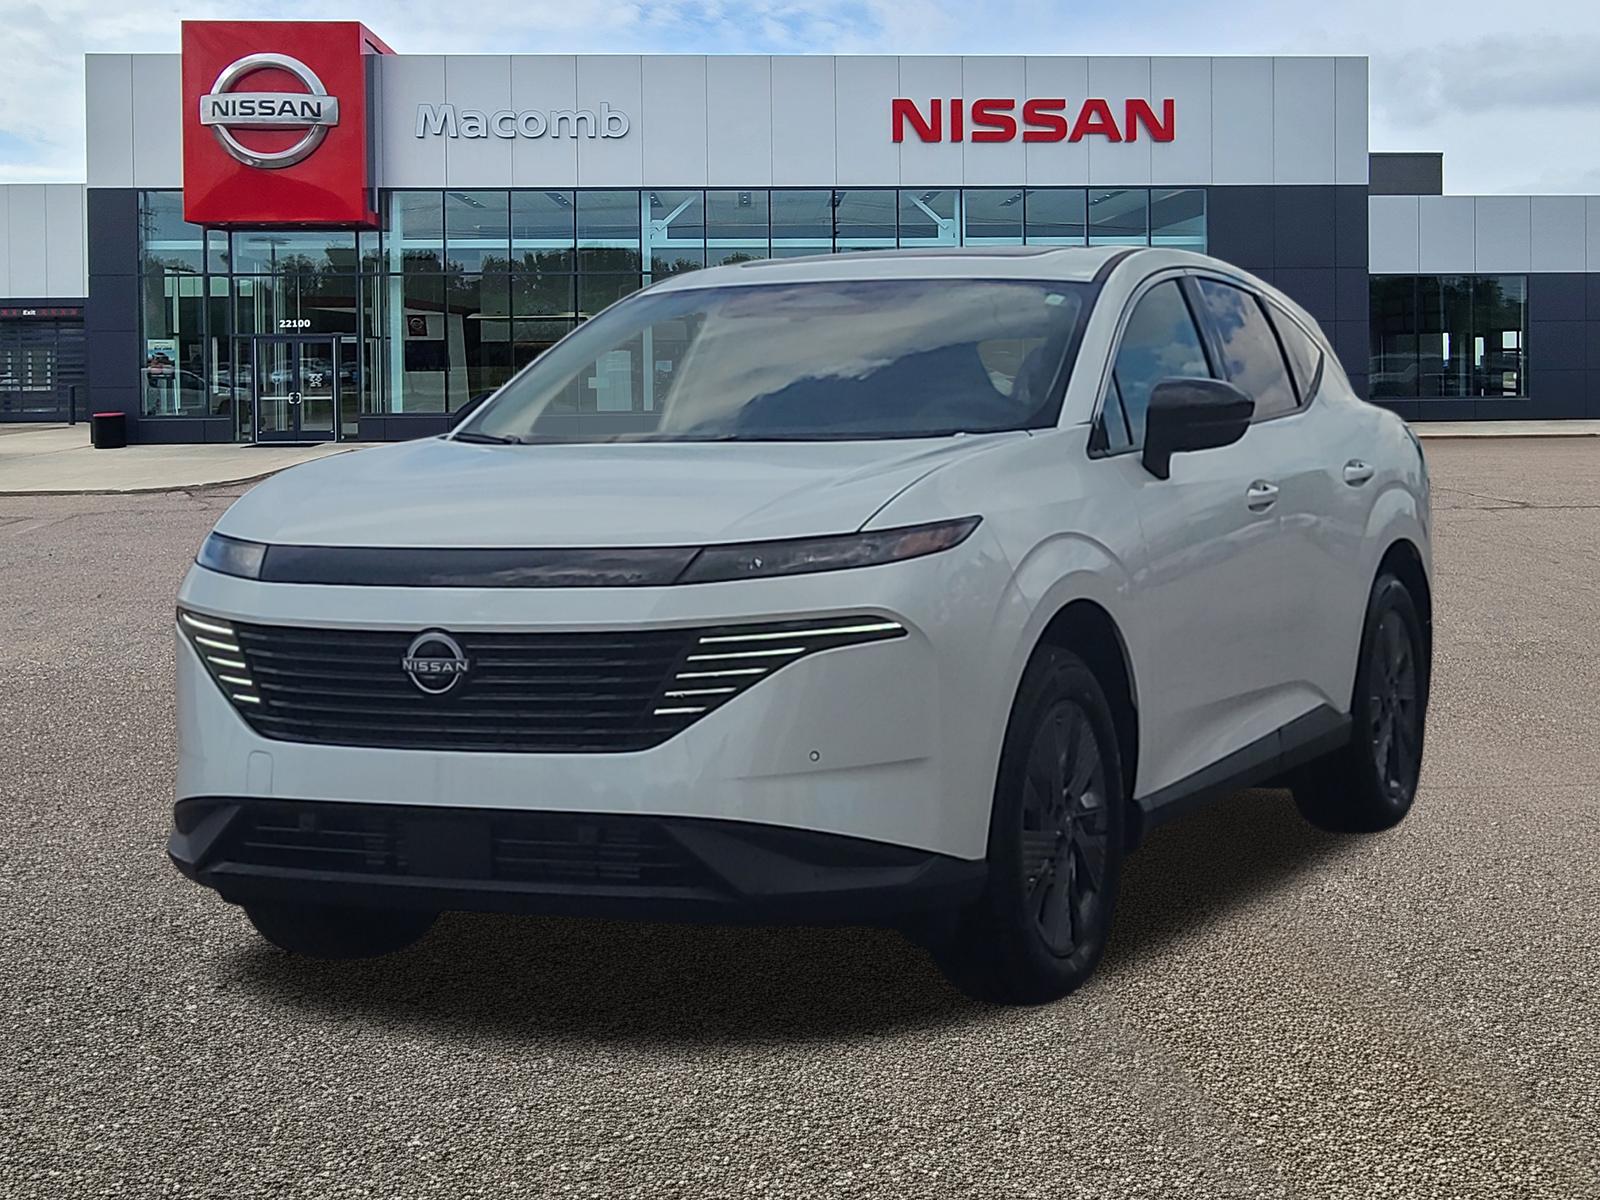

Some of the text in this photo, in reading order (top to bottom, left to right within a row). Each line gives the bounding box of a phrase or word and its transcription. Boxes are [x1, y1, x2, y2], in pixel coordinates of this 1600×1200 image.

[211, 100, 322, 117] NISSAN
[415, 102, 630, 139] Macomb
[892, 98, 1176, 143] NISSAN
[279, 319, 311, 328] 22100
[402, 658, 468, 672] NISSAN
